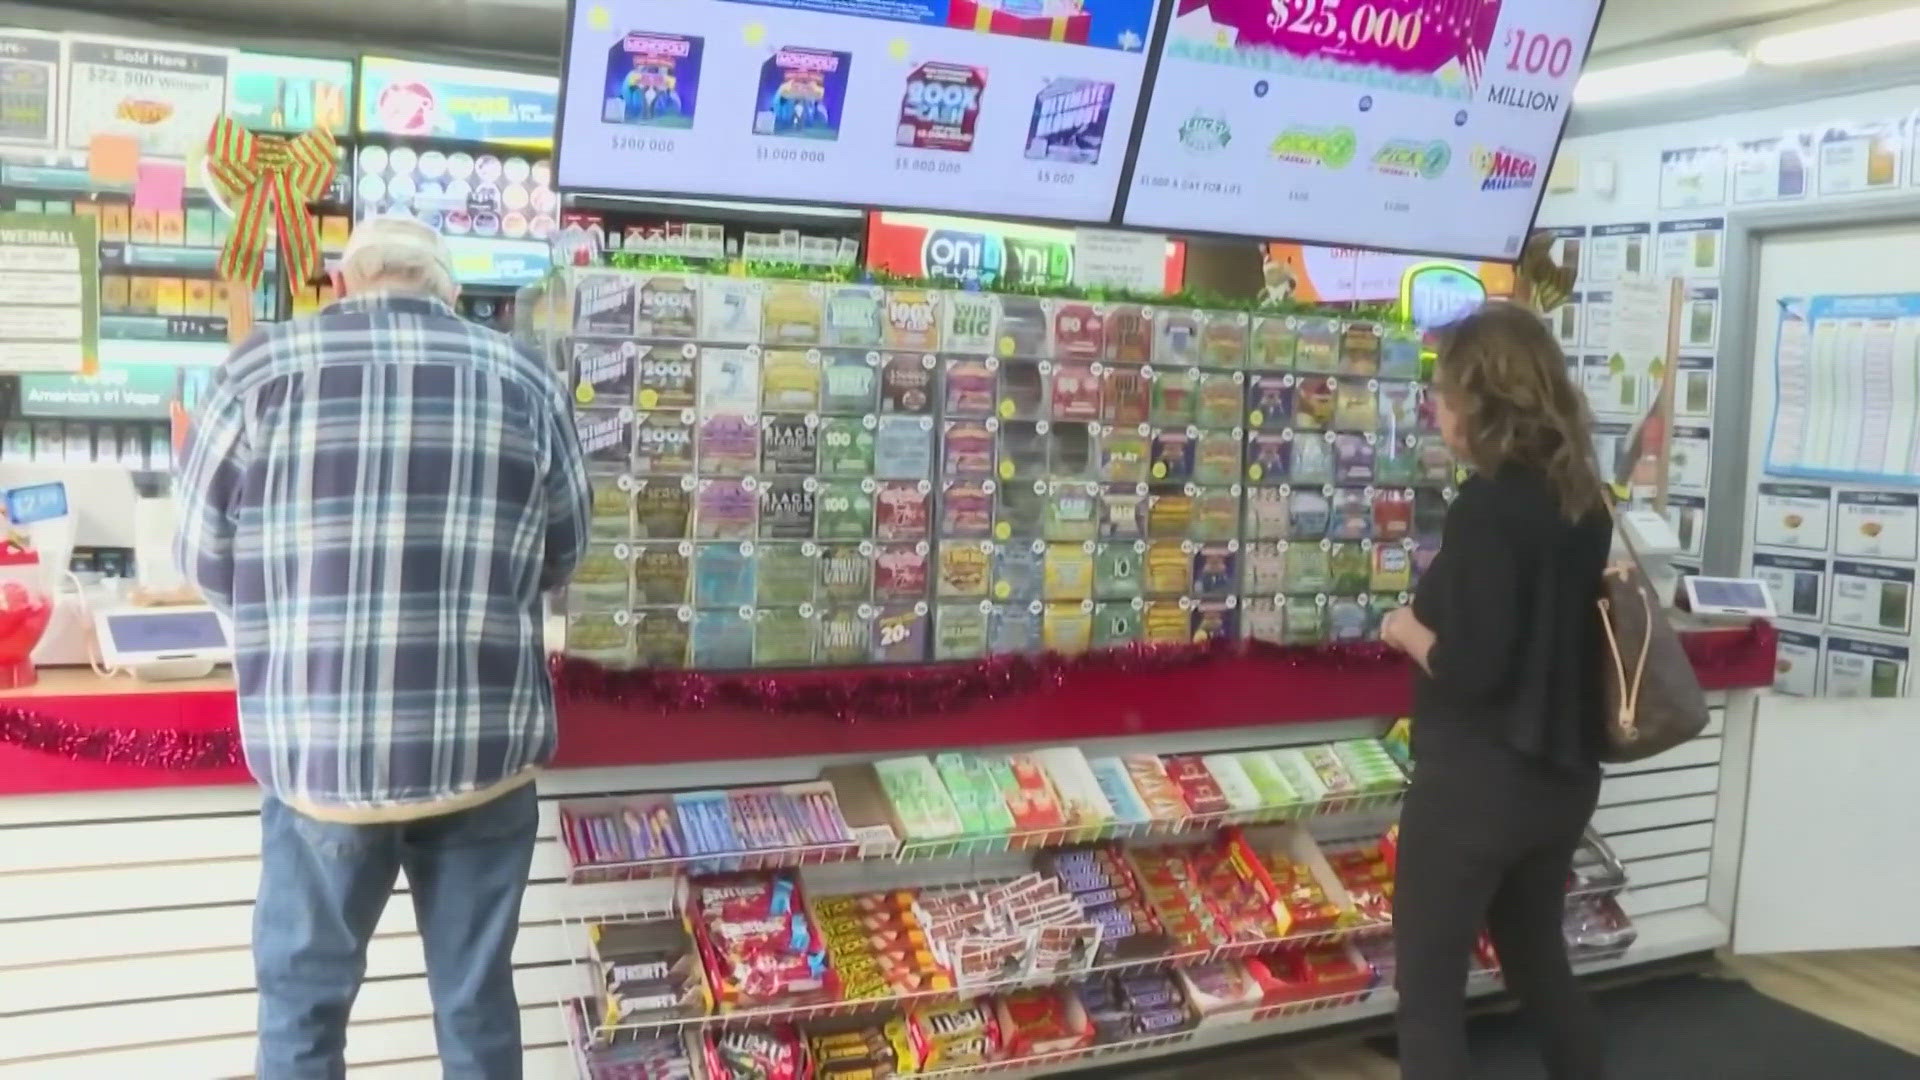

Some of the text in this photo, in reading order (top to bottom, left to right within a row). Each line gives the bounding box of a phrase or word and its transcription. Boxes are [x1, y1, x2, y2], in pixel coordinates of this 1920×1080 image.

[1266, 0, 1421, 50] $25,000
[1504, 28, 1572, 78] $100
[1488, 84, 1560, 112] MILLION
[1490, 151, 1538, 179] MEGA
[954, 304, 992, 319] WIN
[953, 317, 990, 337] BIG
